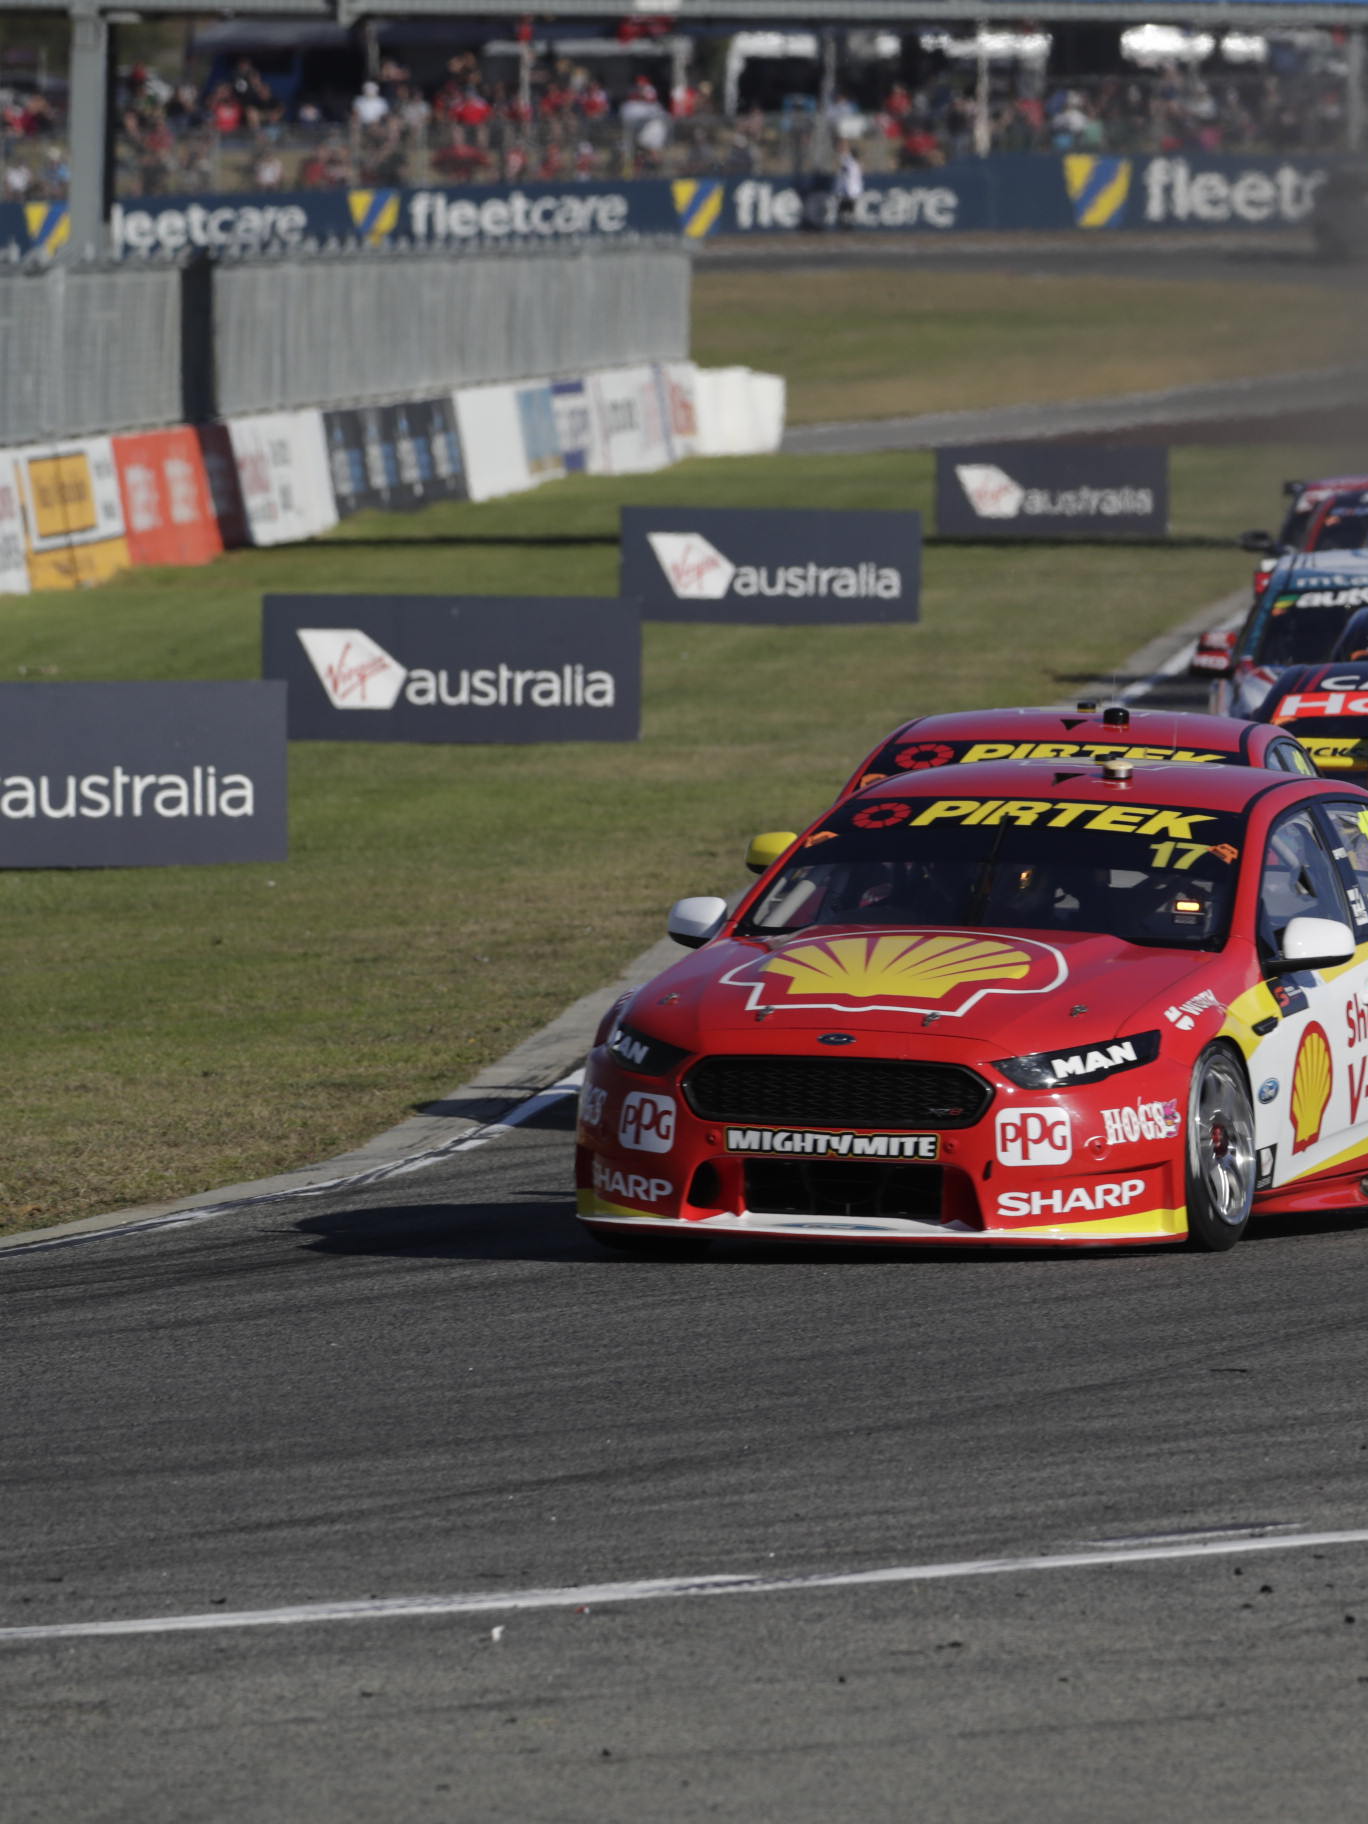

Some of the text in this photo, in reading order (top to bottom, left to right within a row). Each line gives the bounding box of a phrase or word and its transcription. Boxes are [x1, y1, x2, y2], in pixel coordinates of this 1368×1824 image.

[735, 178, 958, 230] flecare
[1143, 156, 1328, 222] fleet
[112, 202, 307, 248] leetcare
[409, 192, 628, 237] fleetcare
[1022, 484, 1153, 516] australia
[733, 562, 901, 599] australia
[325, 642, 616, 707] Virgin australia
[0, 765, 255, 818] australia
[908, 800, 1219, 840] PIRTEK
[1148, 841, 1210, 870] 17
[1052, 1041, 1138, 1079] MAN
[621, 1097, 673, 1145] PPG
[1000, 1112, 1067, 1160] PPG
[997, 1179, 1146, 1217] SHARP
